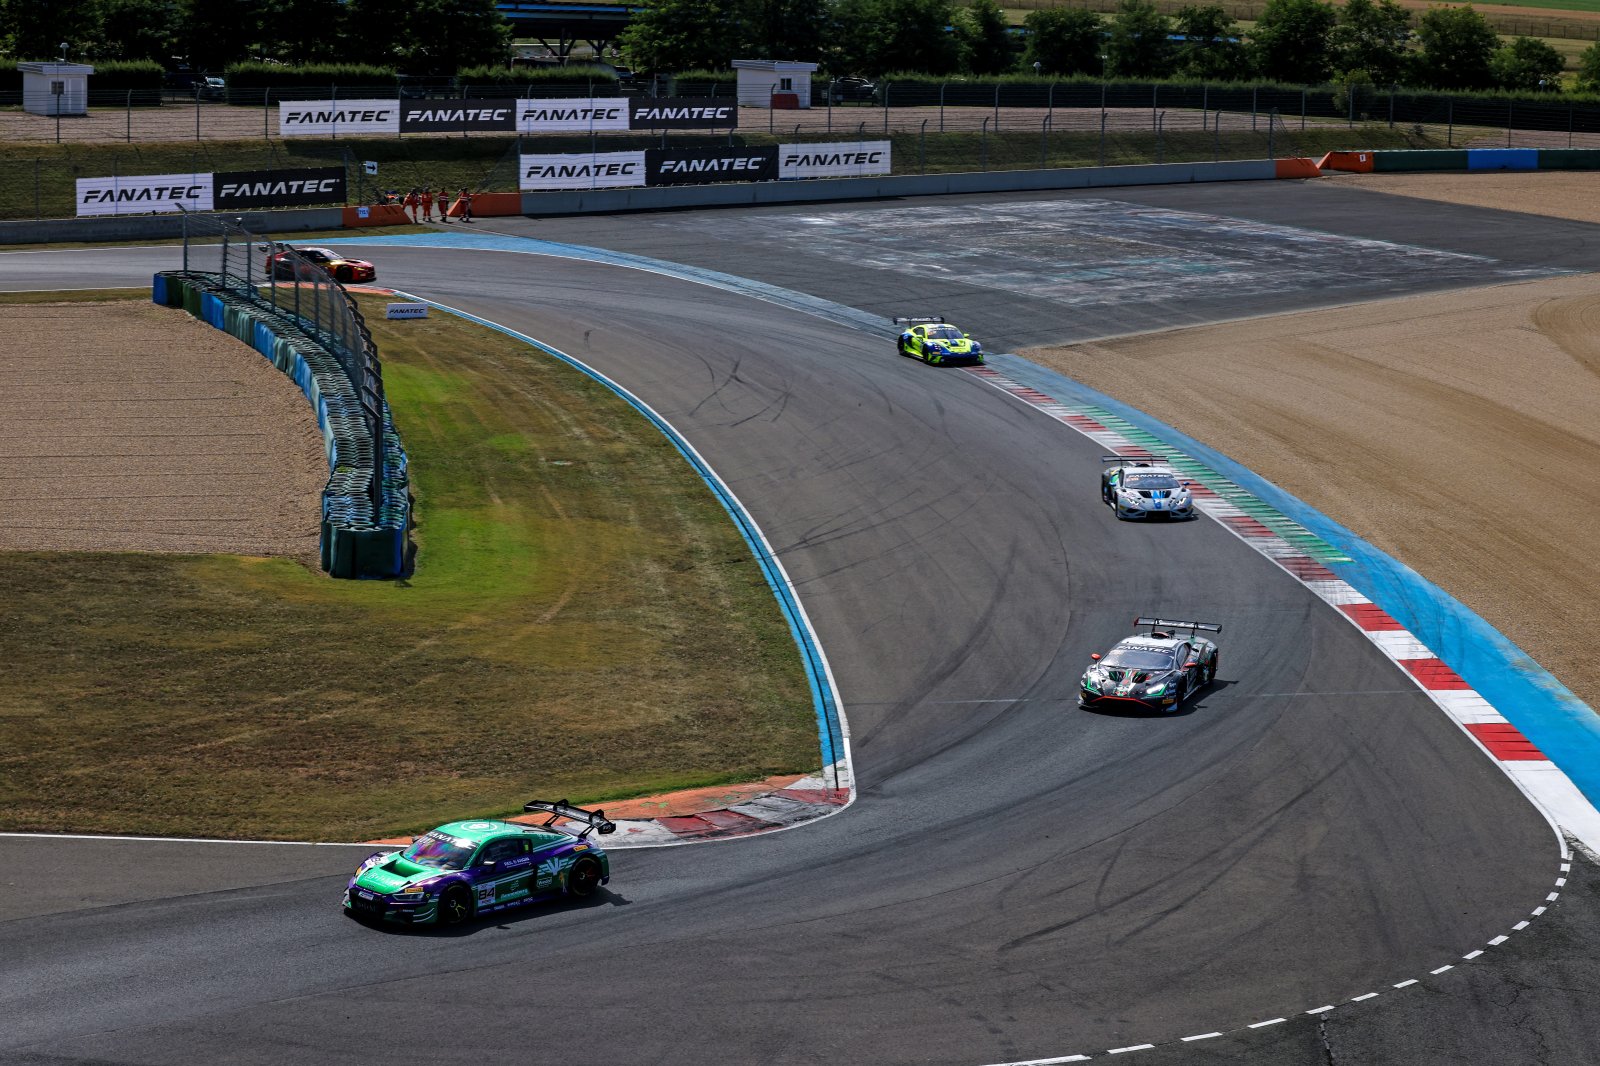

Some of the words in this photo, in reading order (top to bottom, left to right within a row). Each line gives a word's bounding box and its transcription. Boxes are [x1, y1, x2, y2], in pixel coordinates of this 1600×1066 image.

[286, 110, 391, 124] FANATEC
[406, 108, 507, 122] FANATEC
[522, 108, 620, 121] FANATEC
[634, 107, 729, 120] FANATEC
[660, 157, 762, 174] FANATEC
[784, 152, 881, 167] FANATEC
[526, 163, 635, 178] FANATEC
[83, 185, 203, 204] FANATEC
[220, 179, 335, 198] FANATEC
[478, 888, 494, 900] 84
